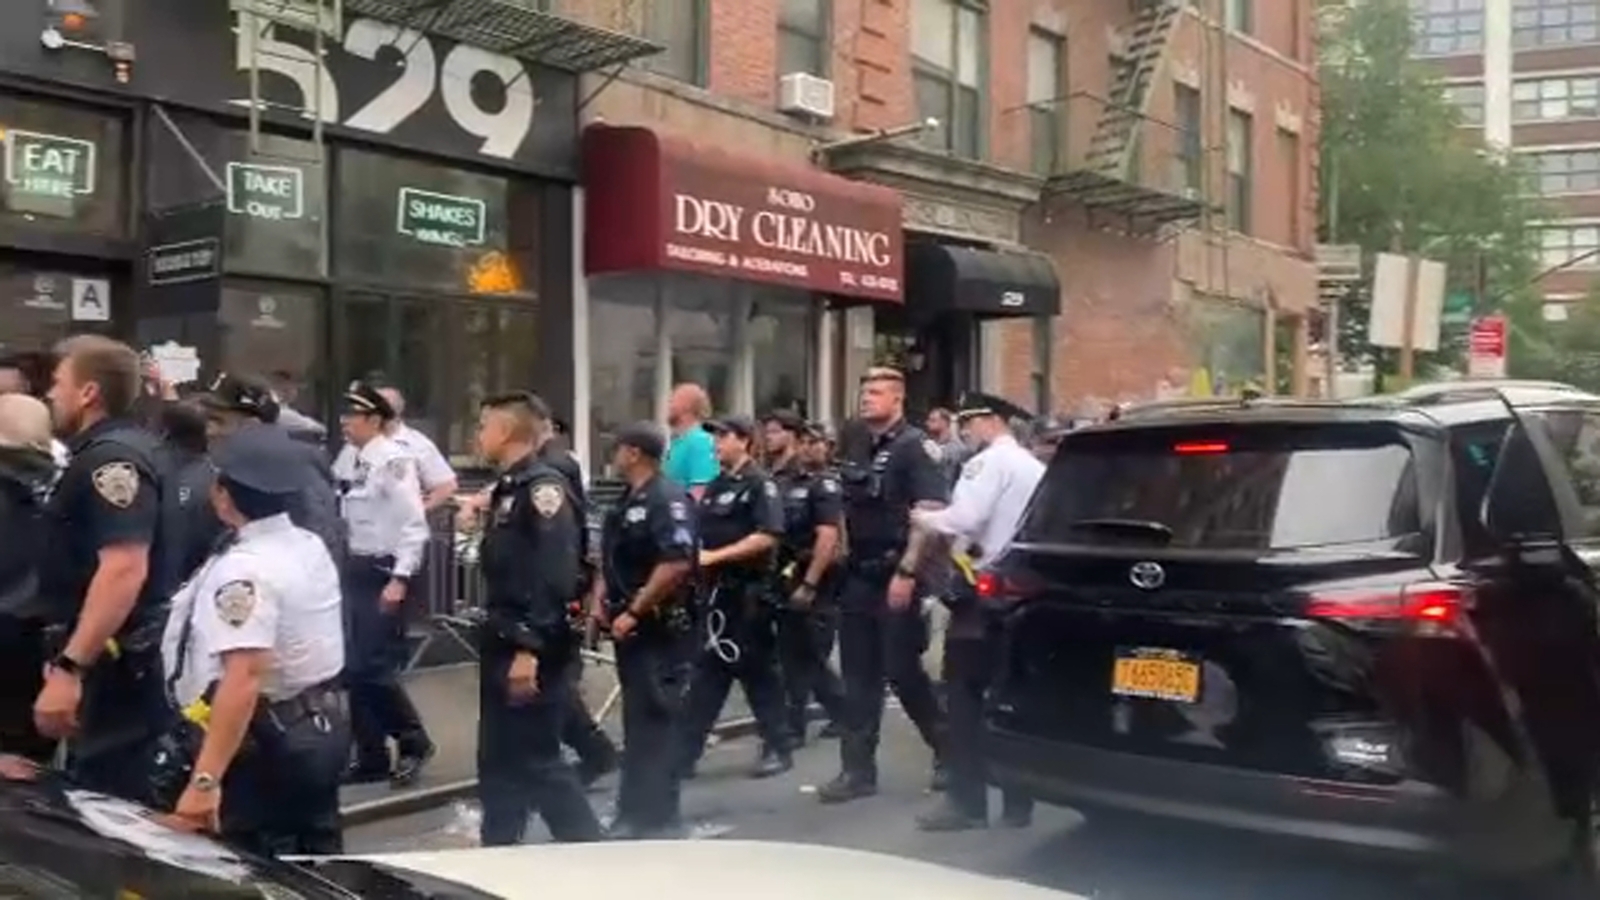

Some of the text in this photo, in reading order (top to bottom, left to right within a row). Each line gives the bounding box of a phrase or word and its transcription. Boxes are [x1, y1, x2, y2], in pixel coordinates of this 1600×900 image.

[229, 12, 534, 158] 529
[24, 143, 81, 175] EAT
[244, 171, 292, 198] TAKE
[246, 201, 282, 220] OUT
[409, 199, 476, 227] SHAKES
[675, 194, 891, 267] DRY CLEANING
[80, 284, 102, 309] A
